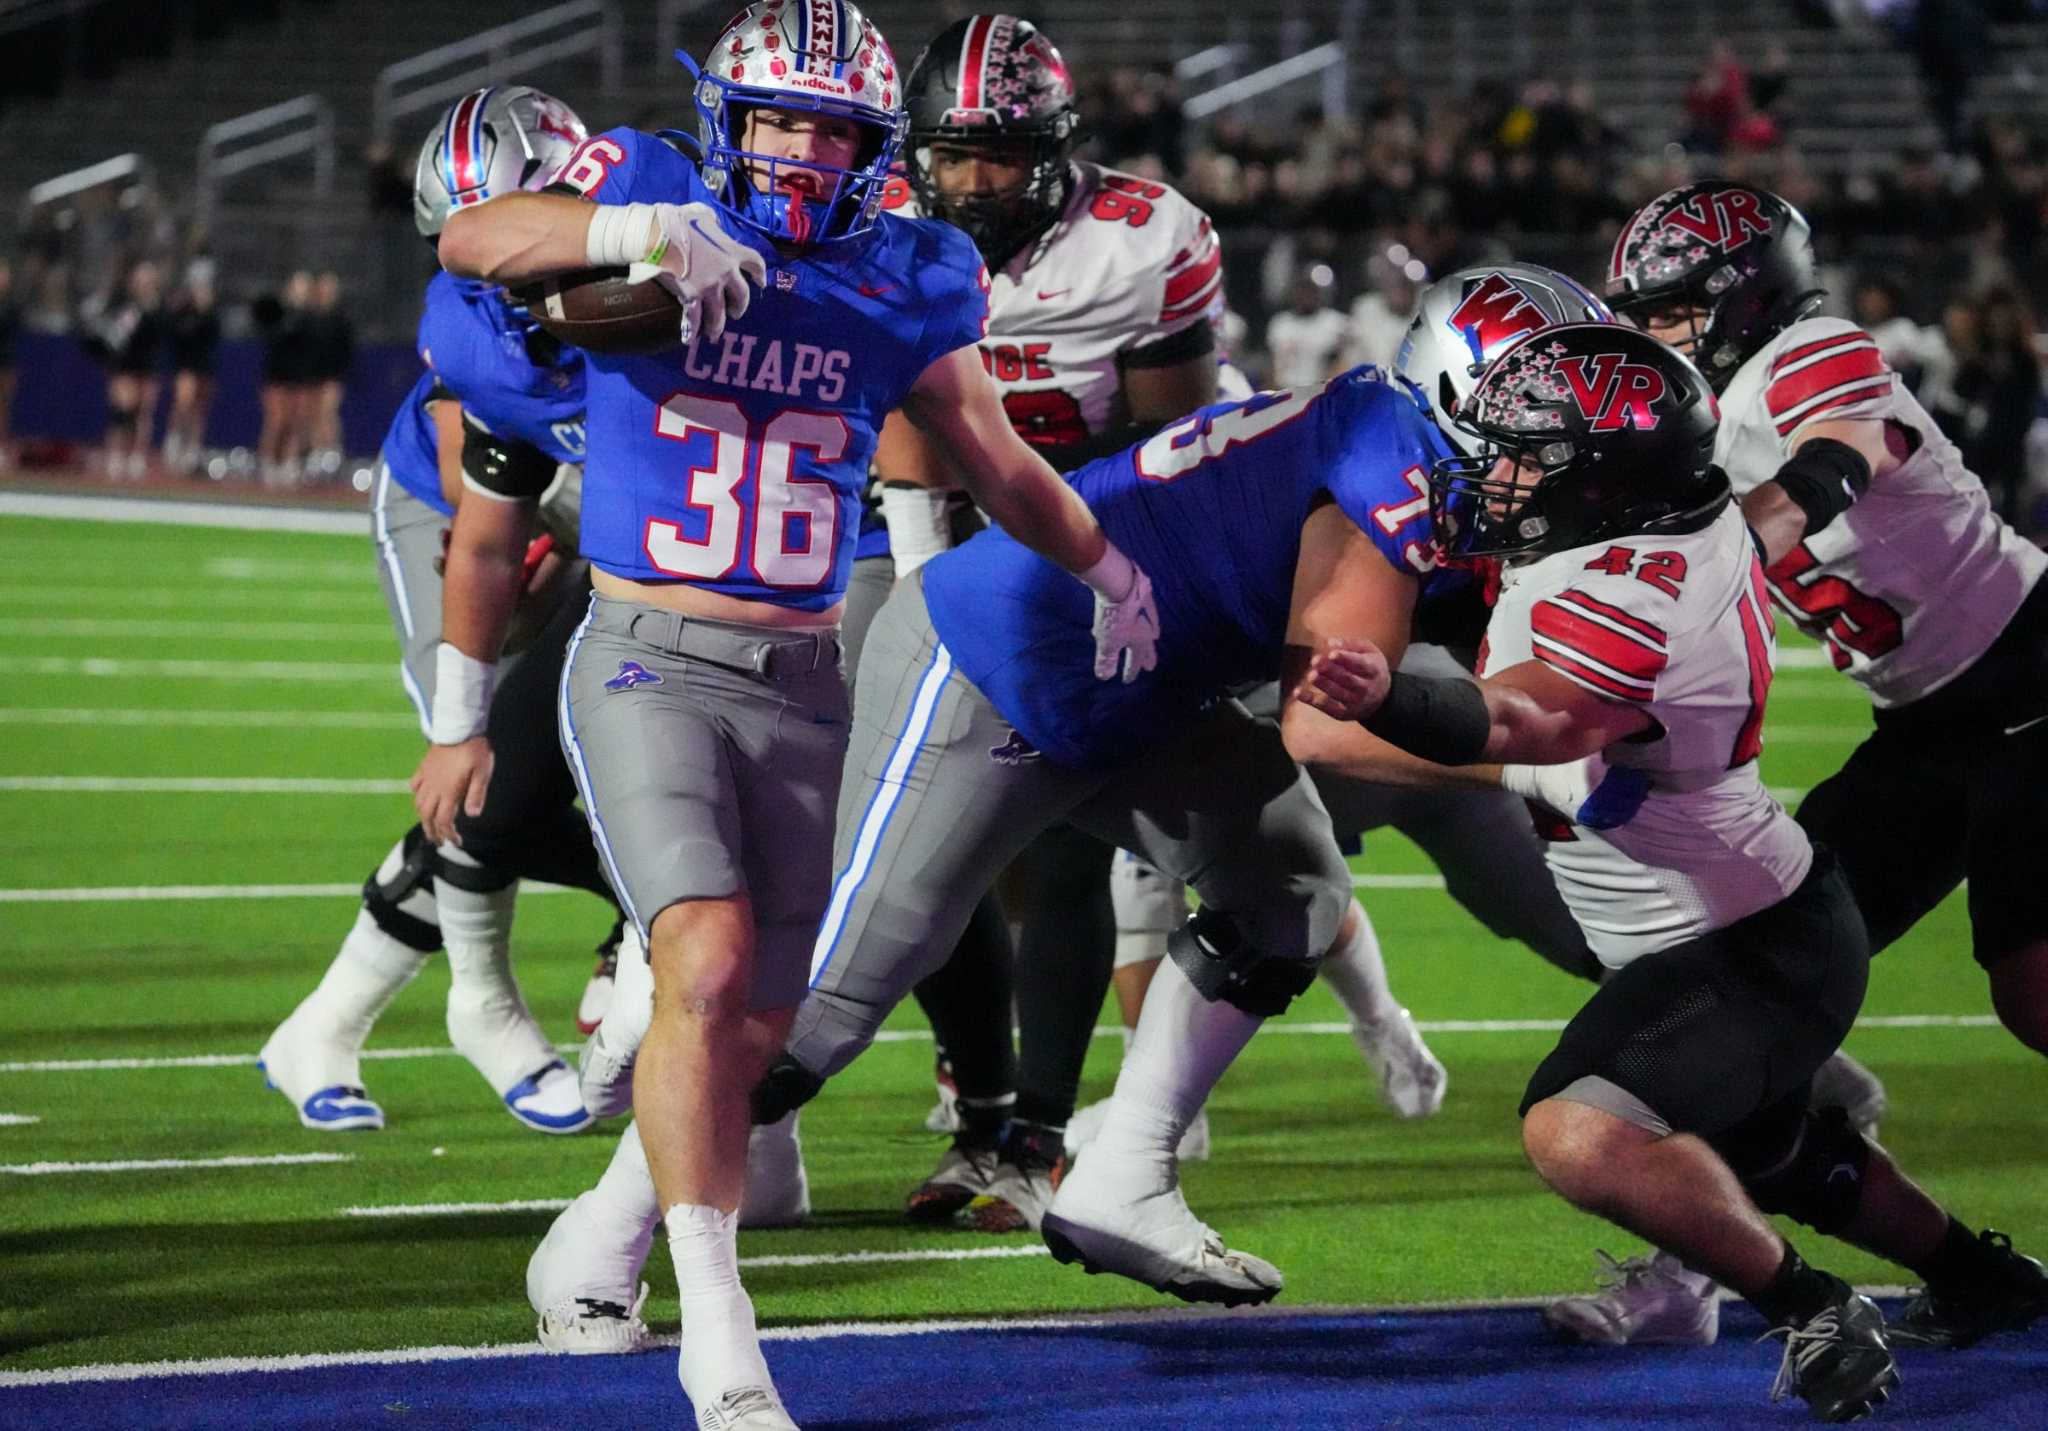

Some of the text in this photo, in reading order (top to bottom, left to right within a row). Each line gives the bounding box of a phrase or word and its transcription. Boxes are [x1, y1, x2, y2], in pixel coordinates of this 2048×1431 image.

[1659, 189, 1772, 254] VR
[1446, 271, 1553, 352] W
[685, 331, 851, 402] CHAPS
[1553, 353, 1665, 433] VR
[644, 391, 852, 592] 36
[1584, 545, 1688, 601] 42
